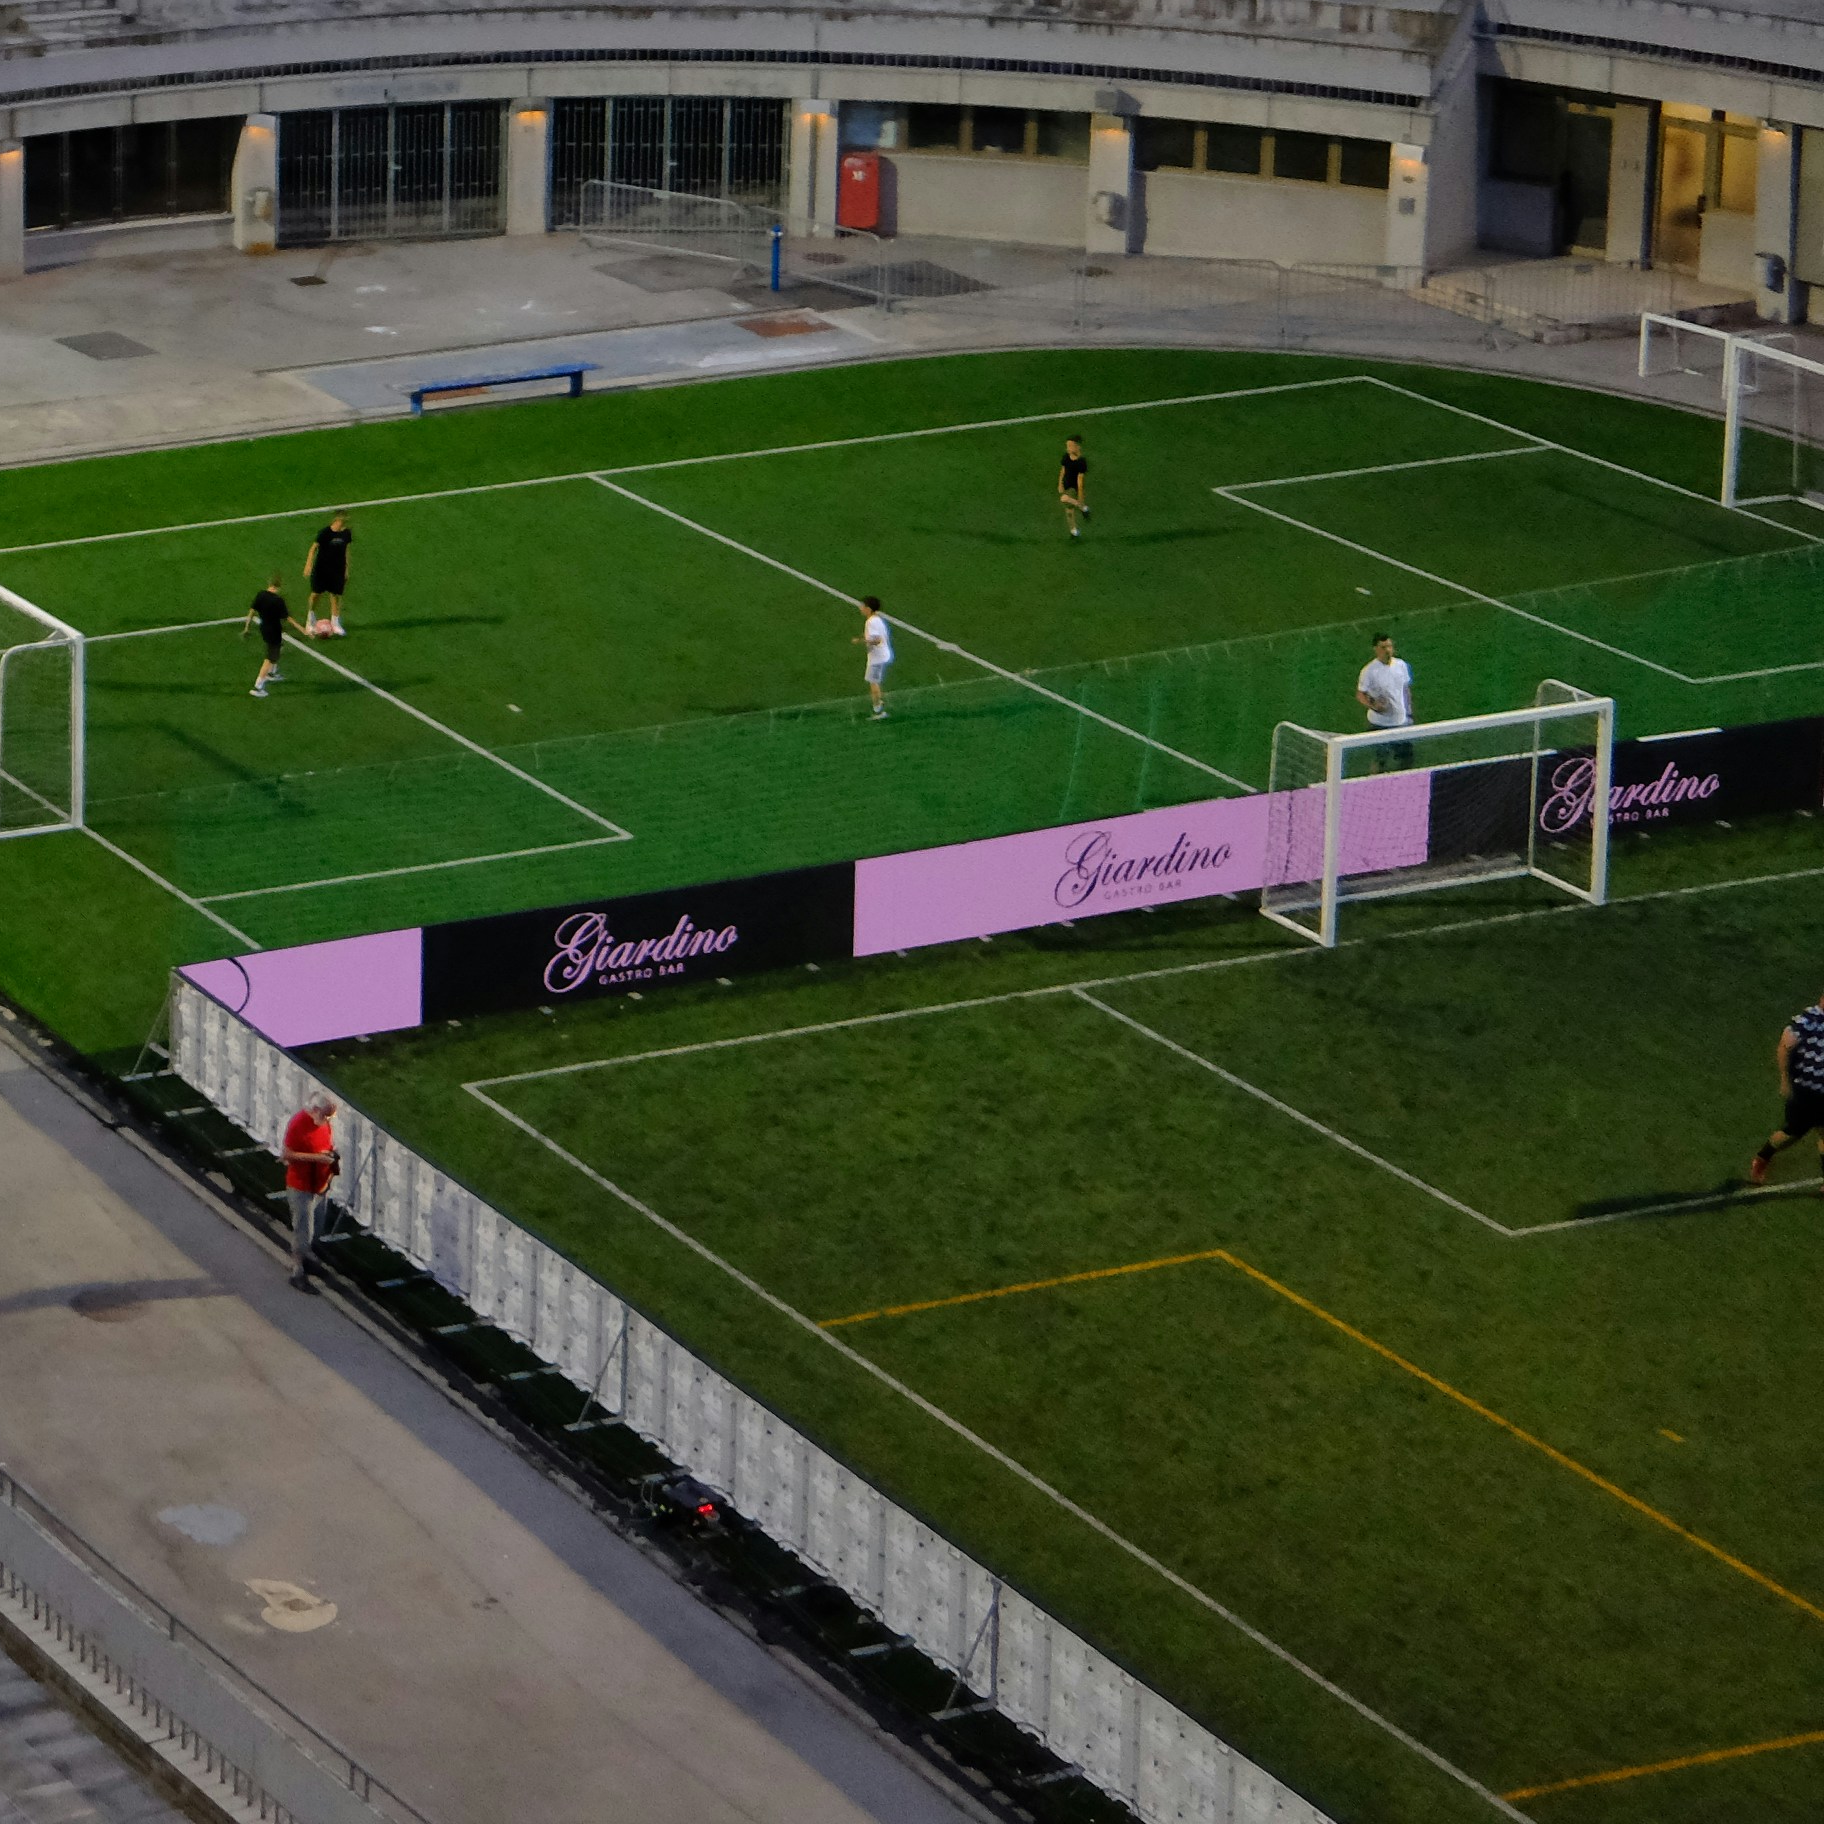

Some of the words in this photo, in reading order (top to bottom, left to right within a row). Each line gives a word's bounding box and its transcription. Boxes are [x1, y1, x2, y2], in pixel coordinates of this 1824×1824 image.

[1539, 757, 1721, 833] Gardino
[1645, 807, 1670, 820] BAR
[1054, 830, 1232, 908] Giardino
[1104, 884, 1152, 900] GASTRO
[1159, 879, 1182, 892] BAR
[543, 911, 739, 994] Giardino
[598, 967, 653, 986] GASTRO
[658, 962, 686, 977] BAR
